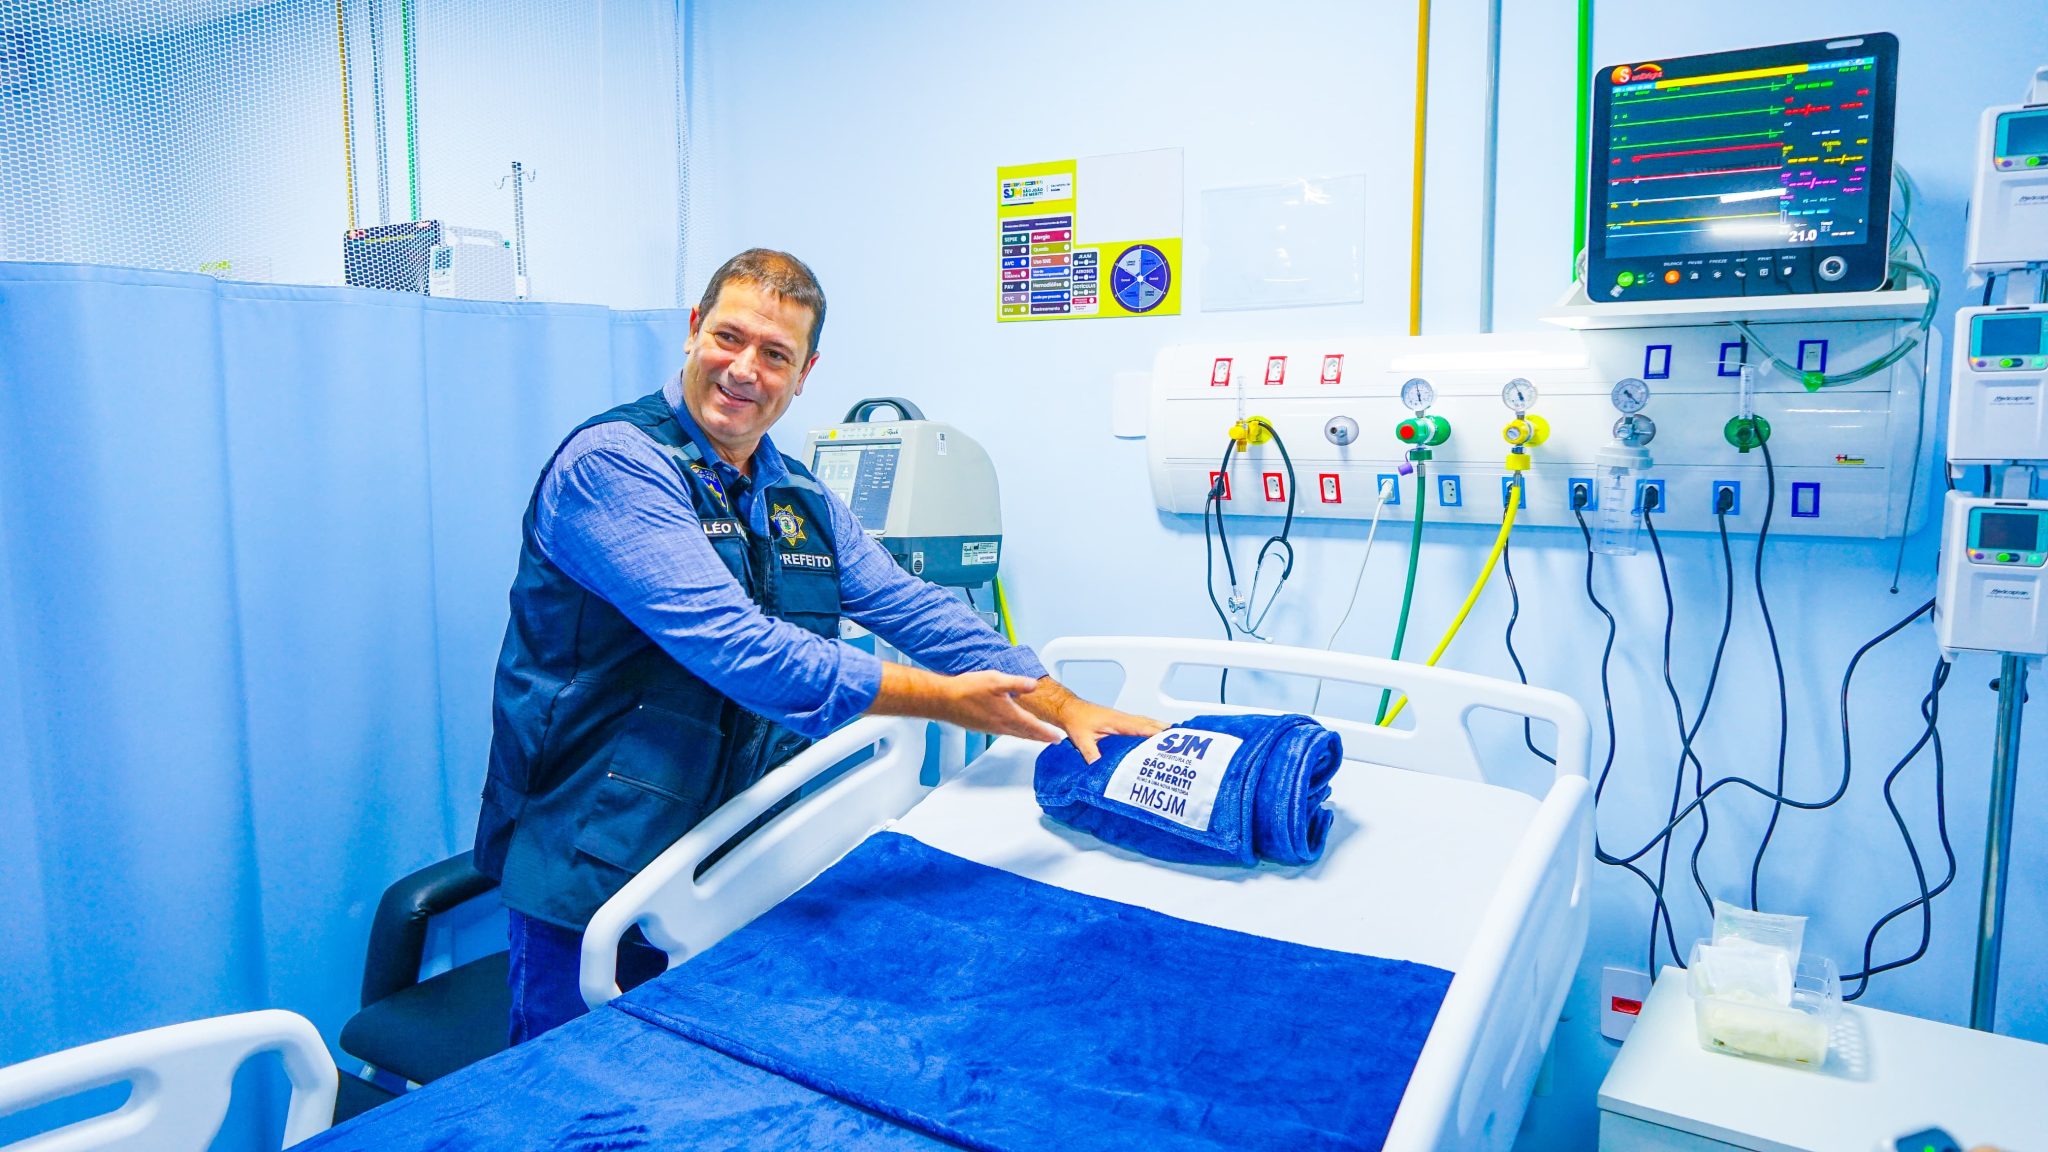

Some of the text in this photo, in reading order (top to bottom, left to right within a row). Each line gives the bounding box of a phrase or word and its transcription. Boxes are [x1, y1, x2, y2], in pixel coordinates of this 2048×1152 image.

[1033, 234, 1051, 242] Alergia
[1788, 229, 1818, 243] 21.0
[702, 521, 732, 535] LÉO
[779, 553, 832, 568] REFEITO
[1156, 733, 1214, 761] SJM
[1157, 752, 1185, 765] PREFEITURA
[1142, 757, 1197, 780] SÃO JOÃO
[1139, 766, 1192, 790] DE MERITI
[1129, 782, 1187, 818] HMSJM
